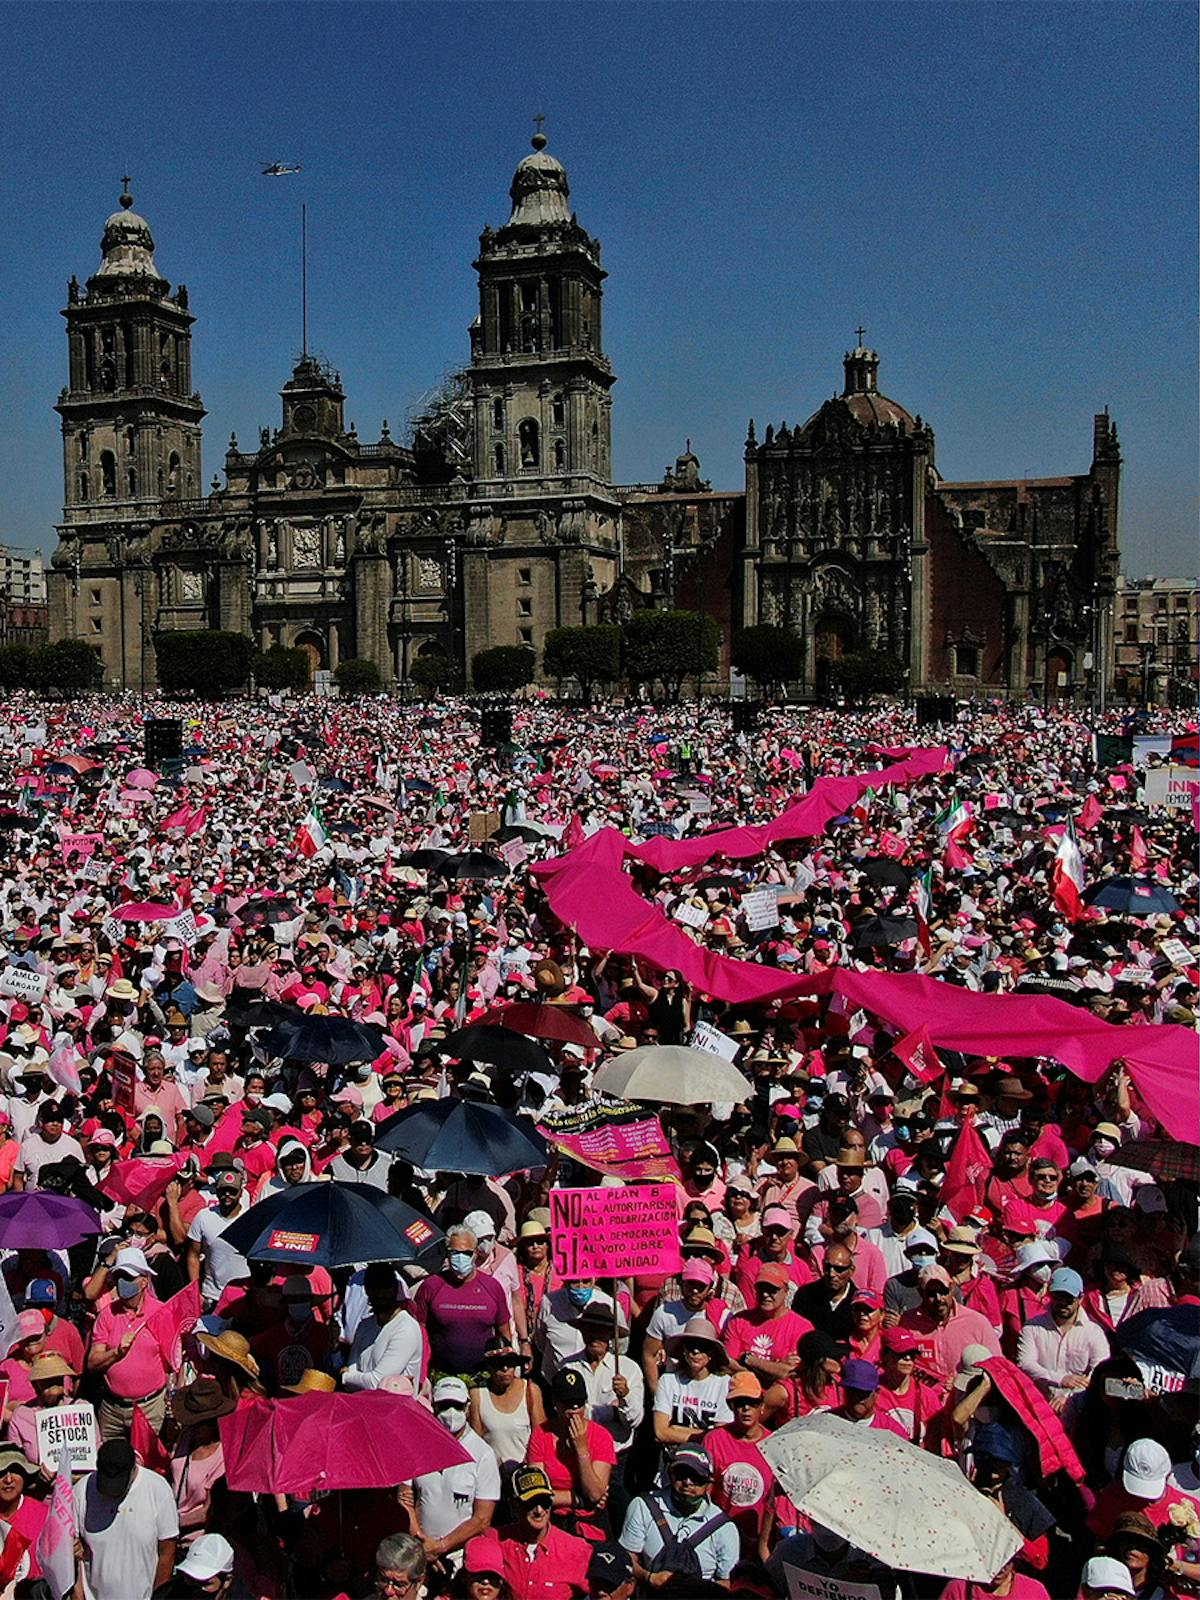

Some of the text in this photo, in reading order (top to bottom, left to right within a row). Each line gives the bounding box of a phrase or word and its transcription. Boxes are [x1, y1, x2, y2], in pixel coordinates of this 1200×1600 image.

[12, 970, 41, 983] AMLO
[607, 1189, 640, 1200] PLAN
[553, 1193, 583, 1229] NO
[583, 1200, 677, 1214] AL AUTORITARISMO
[591, 1216, 605, 1227] LA
[594, 1233, 606, 1242] LA
[610, 1227, 673, 1240] DEMOCRACIA
[284, 1242, 313, 1252] INE
[582, 1240, 665, 1254] AL VOTO LIBRE
[593, 1259, 608, 1270] LA
[615, 1254, 660, 1269] UNIDAD
[700, 1400, 718, 1409] nos
[48, 1427, 89, 1444] SETOCA
[819, 1580, 840, 1593] YO
